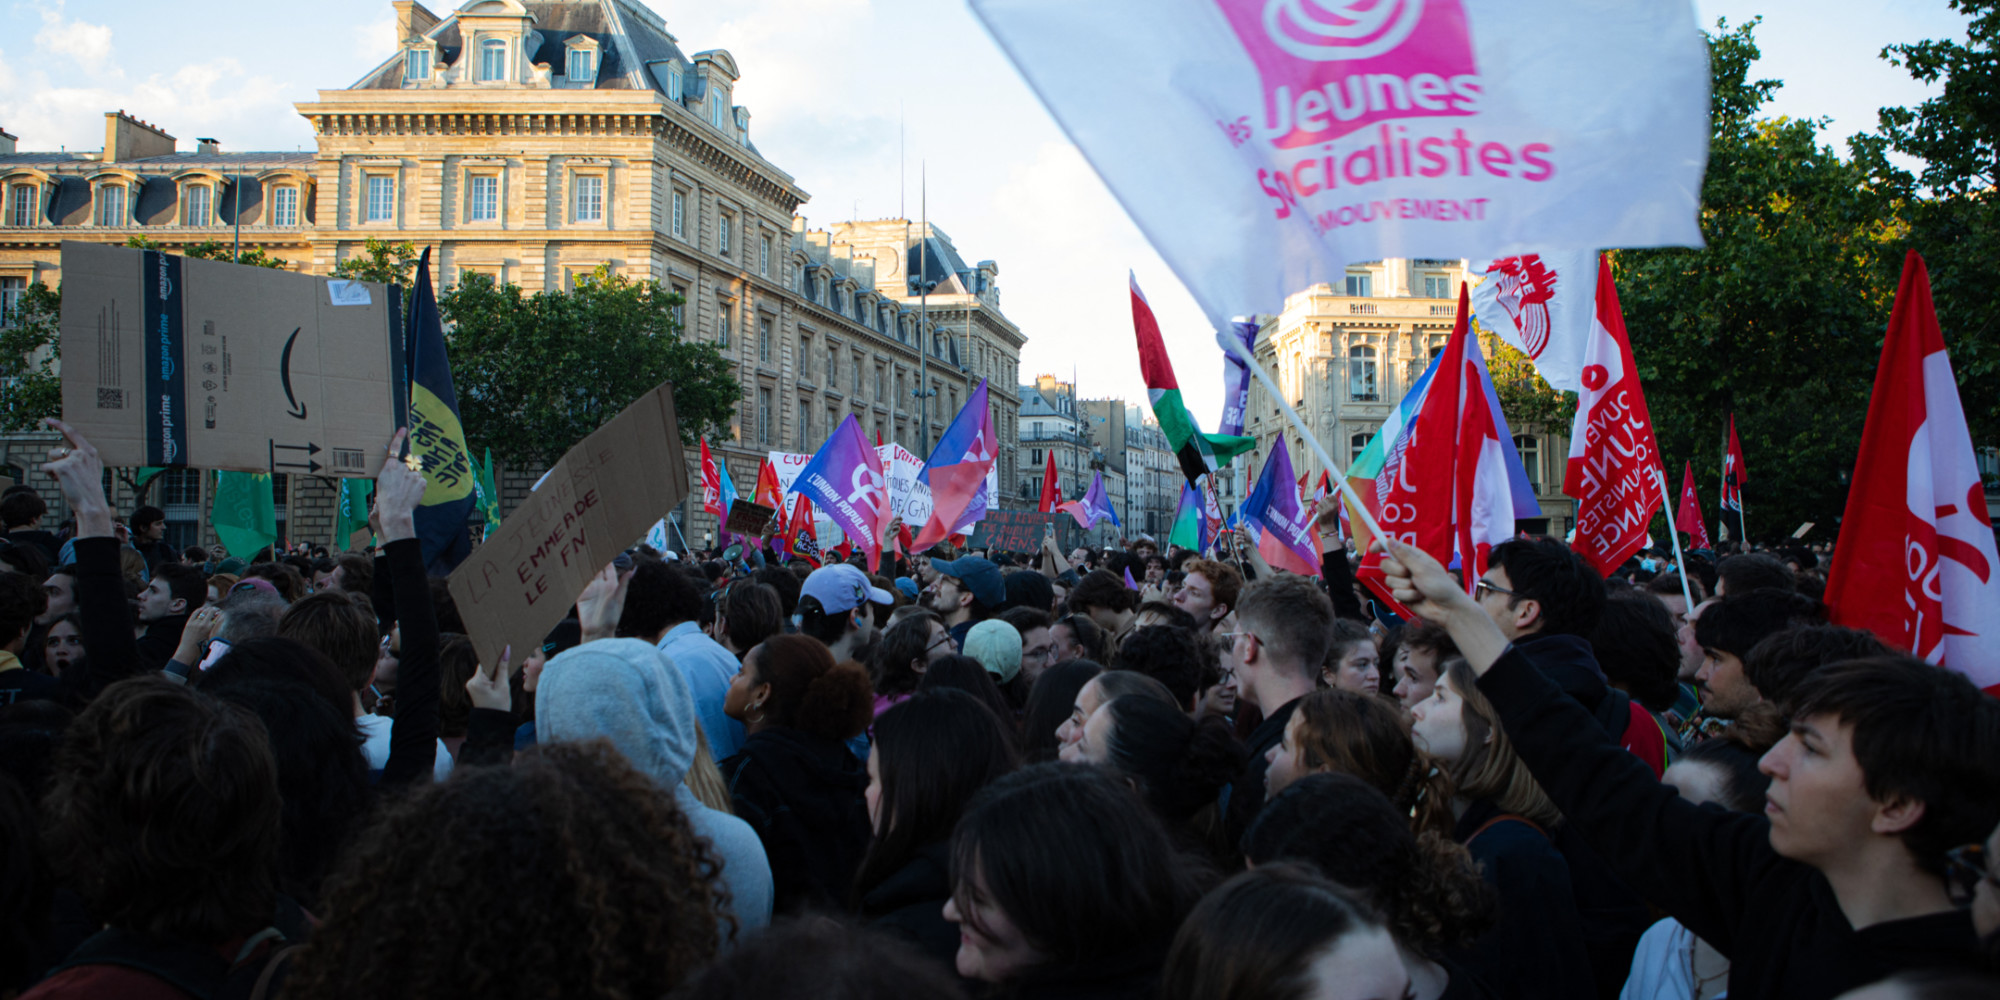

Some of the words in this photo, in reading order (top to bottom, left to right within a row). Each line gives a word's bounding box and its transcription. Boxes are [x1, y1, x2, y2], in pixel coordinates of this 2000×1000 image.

[1270, 72, 1484, 143] Jeunes
[1257, 123, 1556, 220] Socialistes
[1315, 197, 1491, 236] MOUVEMENT
[158, 314, 172, 345] prime
[161, 345, 175, 381] amazon
[160, 394, 174, 427] prime
[162, 427, 178, 464] amazon
[466, 558, 501, 605] LA
[508, 446, 616, 562] JEUNESSE
[806, 472, 842, 503] L'UNION
[836, 499, 876, 547] POPULAIRE
[1265, 504, 1290, 532] L'UNION
[985, 533, 1038, 553] CHIENS
[525, 574, 550, 606] LE
[560, 527, 587, 568] FN
